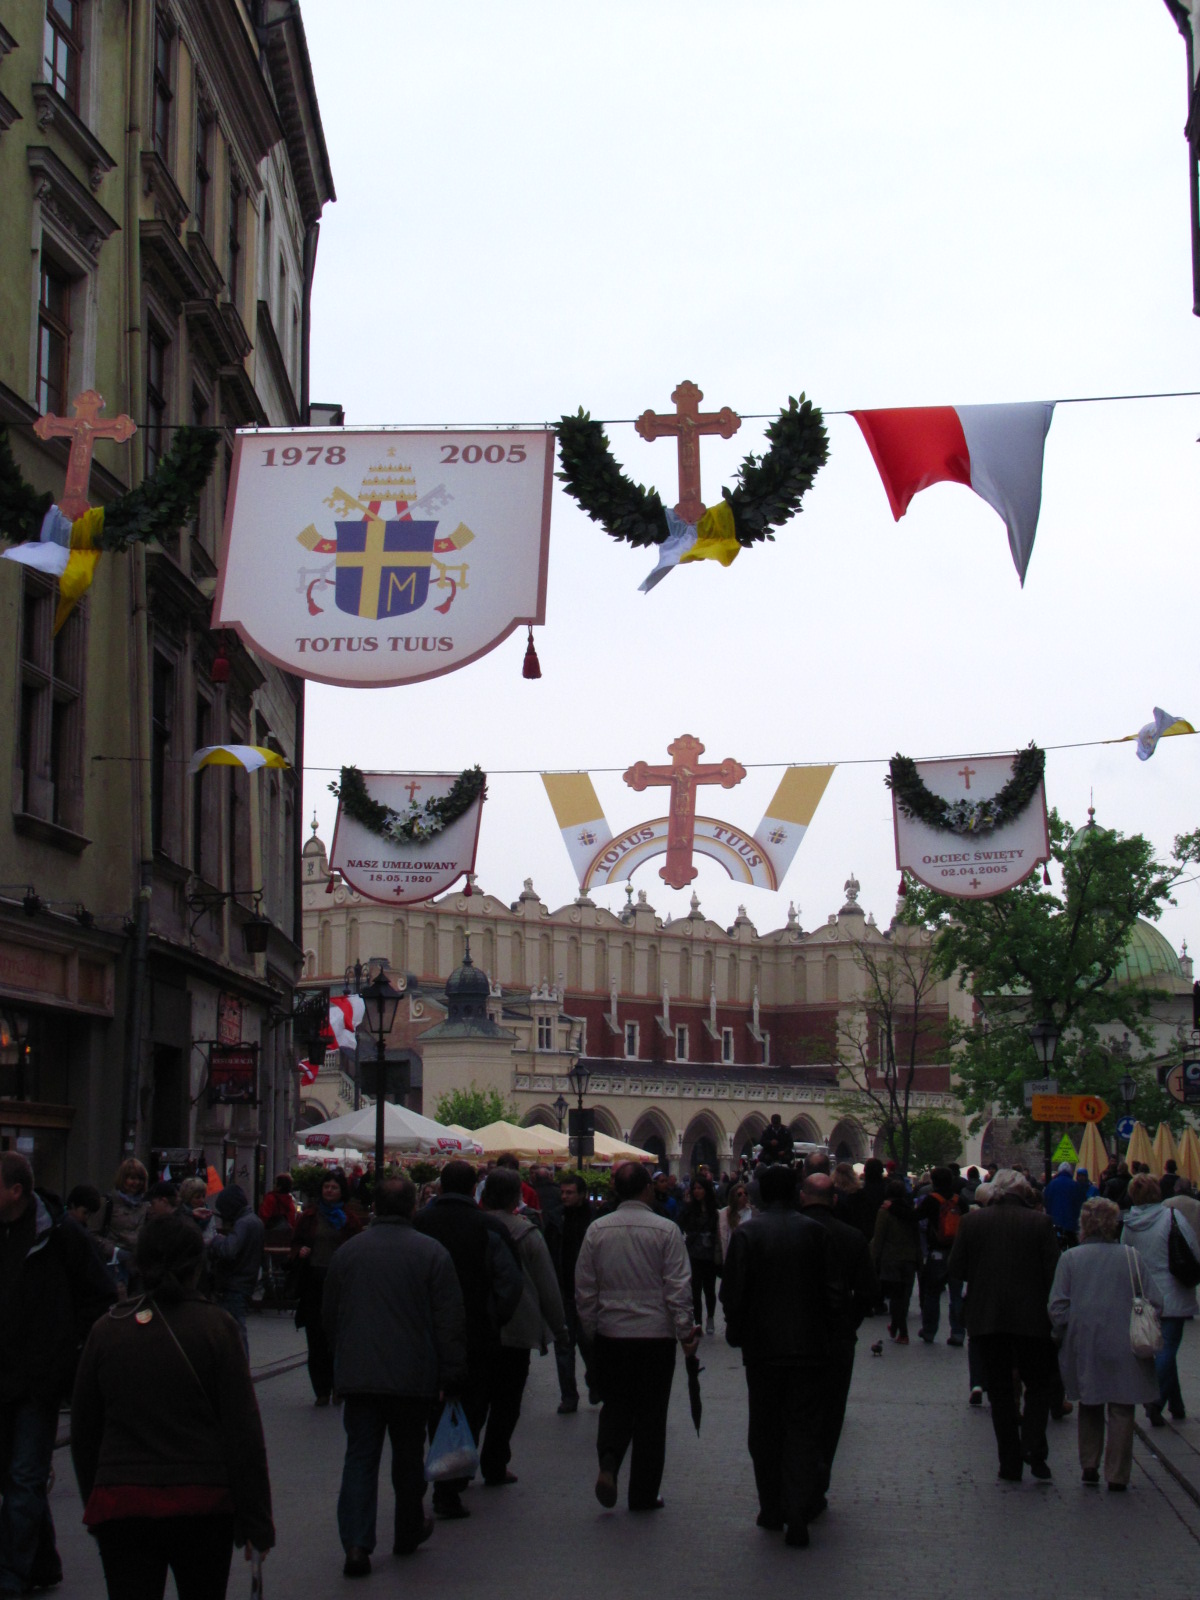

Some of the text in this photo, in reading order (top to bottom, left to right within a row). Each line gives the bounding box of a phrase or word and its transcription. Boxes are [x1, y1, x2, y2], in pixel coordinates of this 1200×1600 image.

[260, 444, 527, 467] 1978 2005
[387, 572, 417, 612] M
[295, 636, 454, 653] TOTUS TUUS
[595, 826, 763, 873] TOTUS TUUS
[347, 860, 457, 870] NASZ UMIŁOWANY
[922, 852, 970, 864] OJCIEC
[369, 874, 432, 882] 18.05.1920
[941, 865, 1008, 877] 02.04.2005
